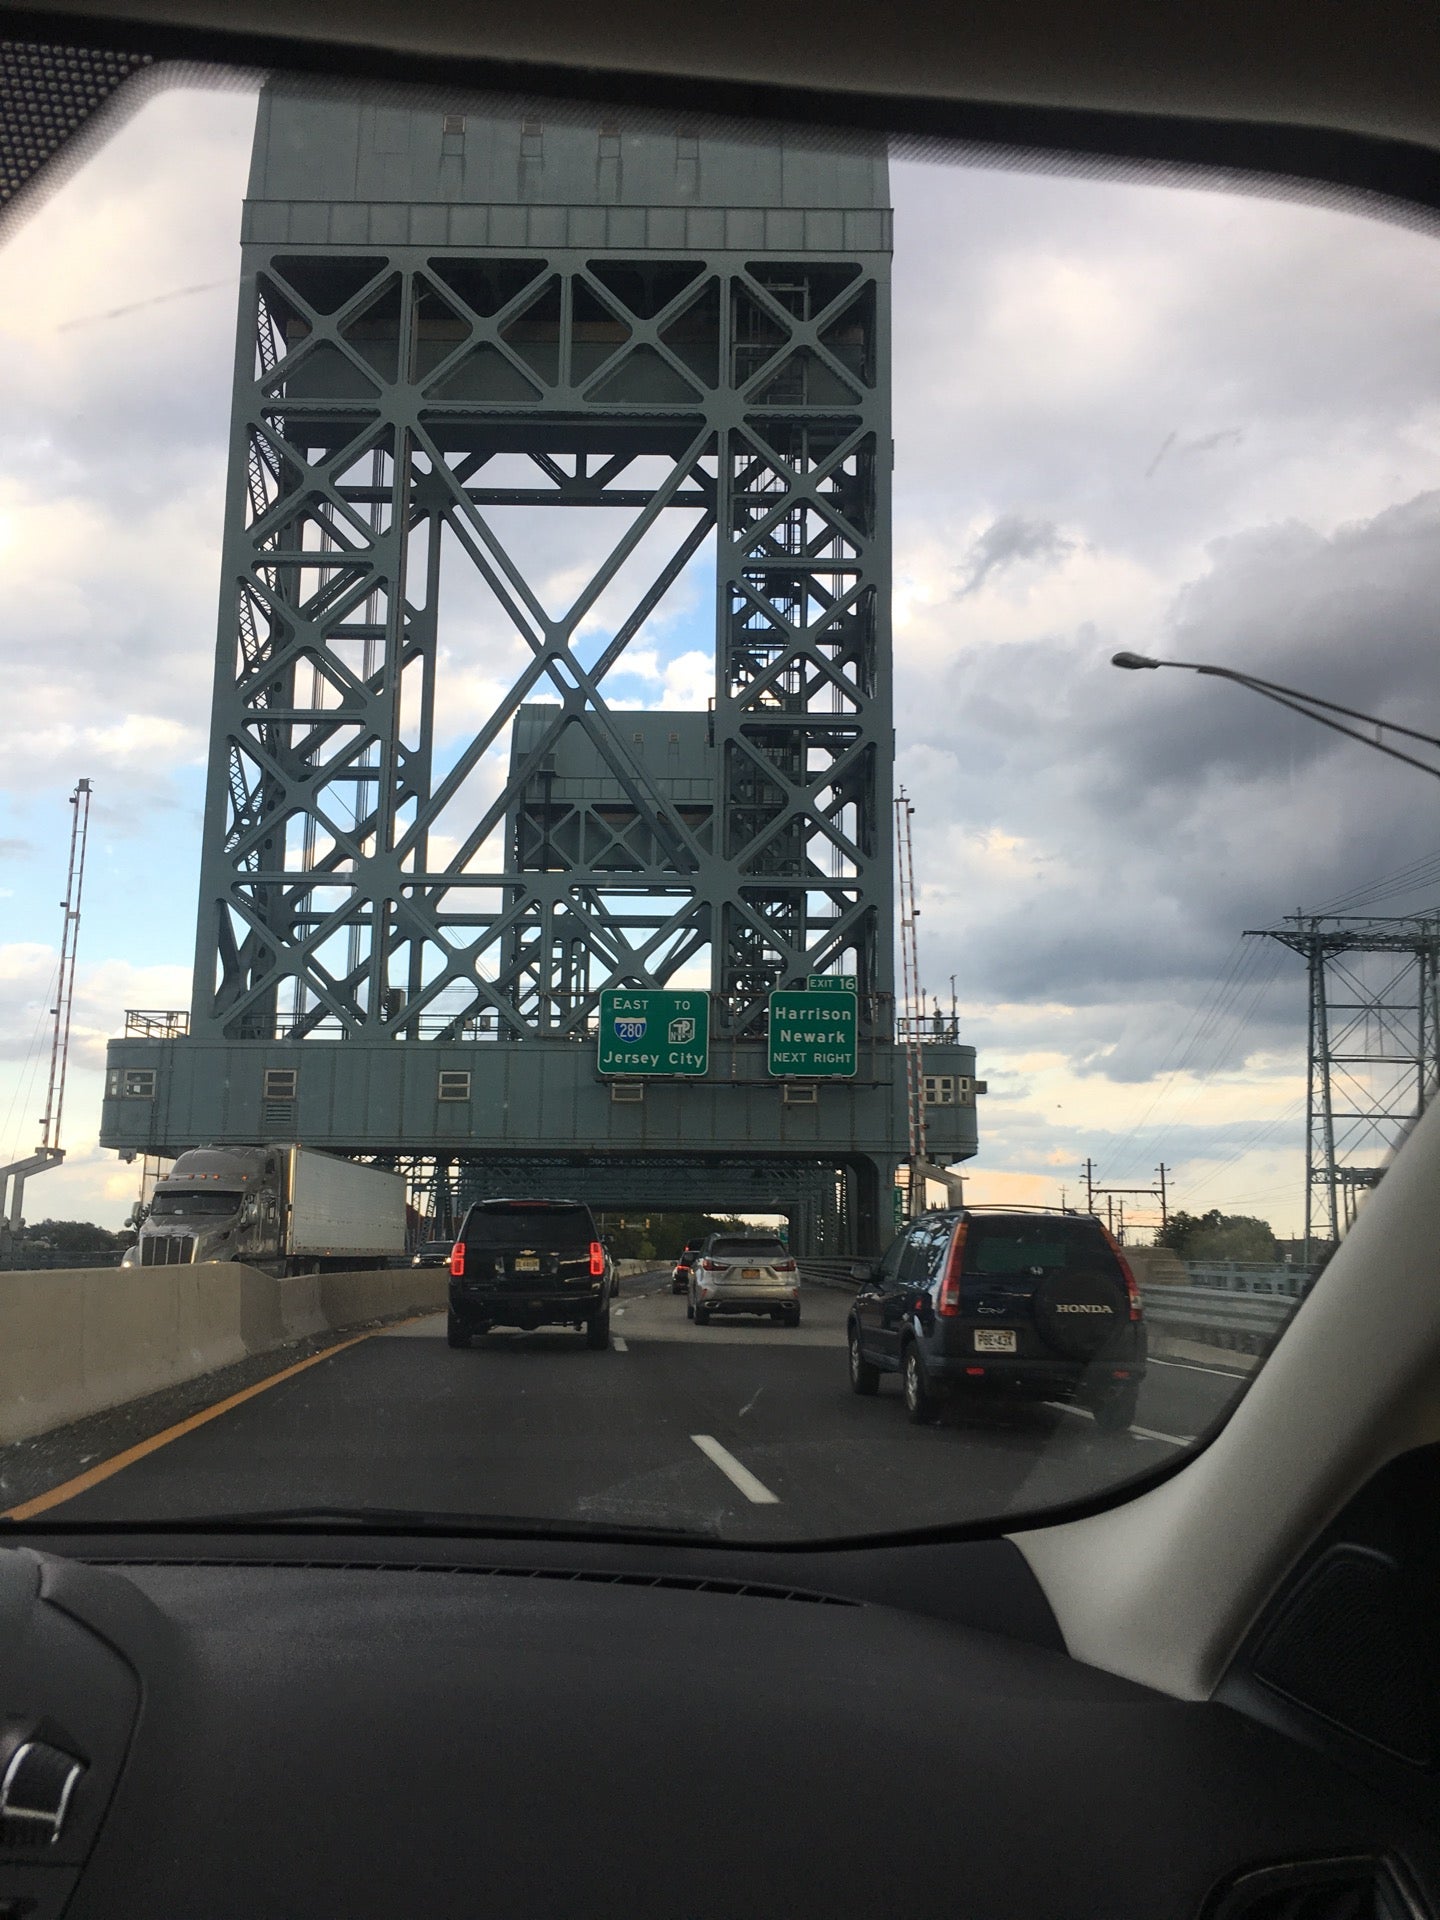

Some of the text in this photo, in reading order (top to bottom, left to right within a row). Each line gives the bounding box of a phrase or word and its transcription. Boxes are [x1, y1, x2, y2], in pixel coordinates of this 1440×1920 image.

[810, 978, 855, 990] EXIT 16
[613, 997, 649, 1010] EAST
[674, 1000, 691, 1011] TO
[775, 1006, 851, 1020] Harrison
[620, 1023, 643, 1038] 280
[780, 1029, 846, 1043] Newark
[603, 1051, 704, 1068] Jersey City
[773, 1052, 852, 1063] NEXT RIGHT
[1056, 1304, 1114, 1314] HONDA
